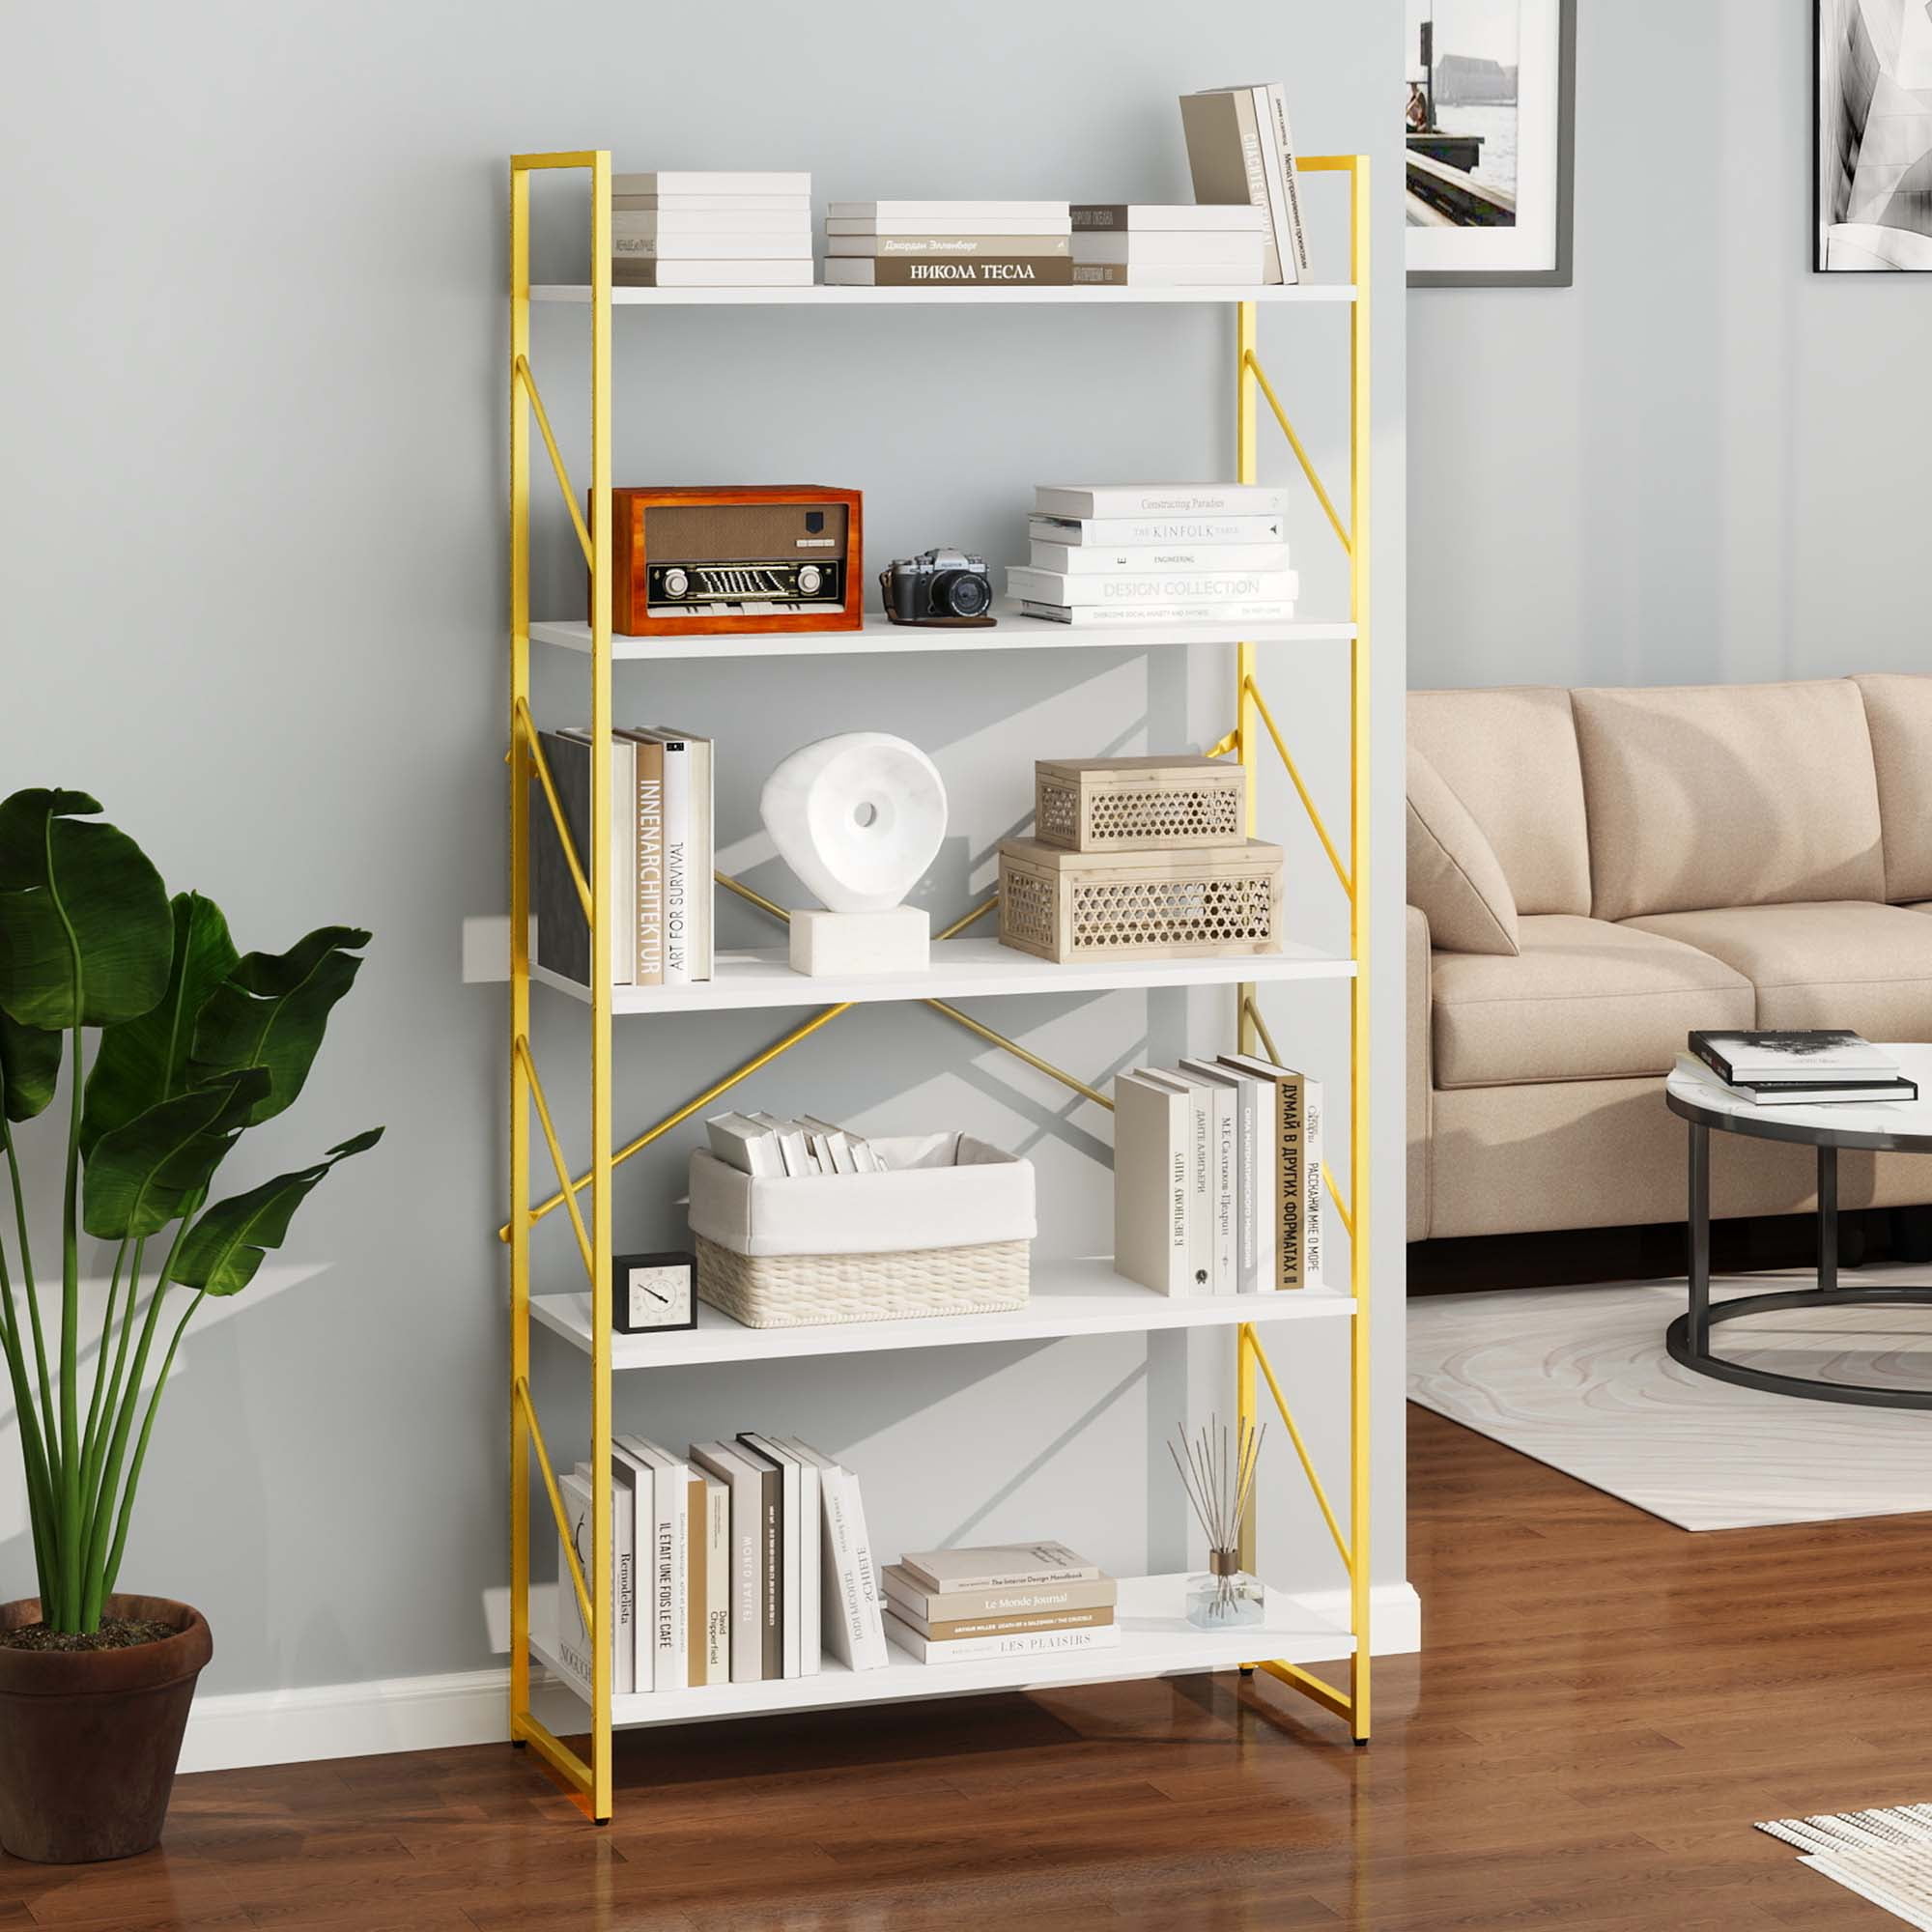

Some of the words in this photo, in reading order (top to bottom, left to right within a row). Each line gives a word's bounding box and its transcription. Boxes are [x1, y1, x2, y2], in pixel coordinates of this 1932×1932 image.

[1243, 131, 1264, 190] СПАСИТЕ
[1284, 153, 1294, 177] Метод
[1287, 178, 1301, 226] управления
[884, 240, 926, 251] Джордан
[928, 240, 979, 252] Элленберг
[1295, 227, 1307, 270] проектами
[910, 264, 977, 280] НИКОЛА
[980, 263, 1037, 280] ТЕСЛА
[1141, 497, 1191, 511] Constructing
[1152, 525, 1214, 539] KINFOLK
[1153, 555, 1196, 564] ENGINEERING
[1103, 582, 1161, 598] DESIGN
[1163, 579, 1261, 596] COLLECTION
[639, 779, 661, 975] INNENARCHITEKTUR
[668, 841, 685, 905] SURVIVAL
[668, 909, 685, 941] FOR
[668, 944, 685, 972] ART
[1282, 1083, 1301, 1131] ДУМАЙ
[1196, 1109, 1207, 1142] ДАНТЕ
[1283, 1134, 1298, 1144] В
[1174, 1151, 1184, 1183] МИРУ
[1197, 1143, 1207, 1194] АЛИГЬЕРИ
[1282, 1147, 1298, 1199] ДРУГИХ
[1218, 1140, 1232, 1236] Салтыков-Щедрин
[1307, 1162, 1320, 1212] РАССКАЖИ
[1174, 1186, 1184, 1237] ВЕЧНОМУ
[1307, 1214, 1320, 1236] МНЕ
[1174, 1238, 1184, 1247] К
[1283, 1201, 1298, 1273] ФОРМАТАХ
[1307, 1246, 1320, 1272] МОРЕ
[659, 1522, 672, 1532] IL
[659, 1533, 673, 1561] ÉTAIT
[659, 1563, 672, 1583] UNE
[1004, 1577, 1027, 1585] Interior
[1027, 1575, 1050, 1584] Design
[1050, 1571, 1083, 1581] Handbook
[620, 1552, 633, 1625] Remodelista
[659, 1585, 672, 1608] FOIS
[984, 1600, 998, 1610] Le
[999, 1596, 1033, 1609] Monde
[1033, 1592, 1068, 1607] Journal
[659, 1609, 672, 1623] LE
[719, 1610, 727, 1635] David
[659, 1623, 673, 1650] CAFÉ
[710, 1610, 719, 1665] Chipperfield
[1000, 1639, 1024, 1653] LES
[1030, 1633, 1092, 1651] PLAISIRS
[560, 1642, 593, 1686] NOGUCH
